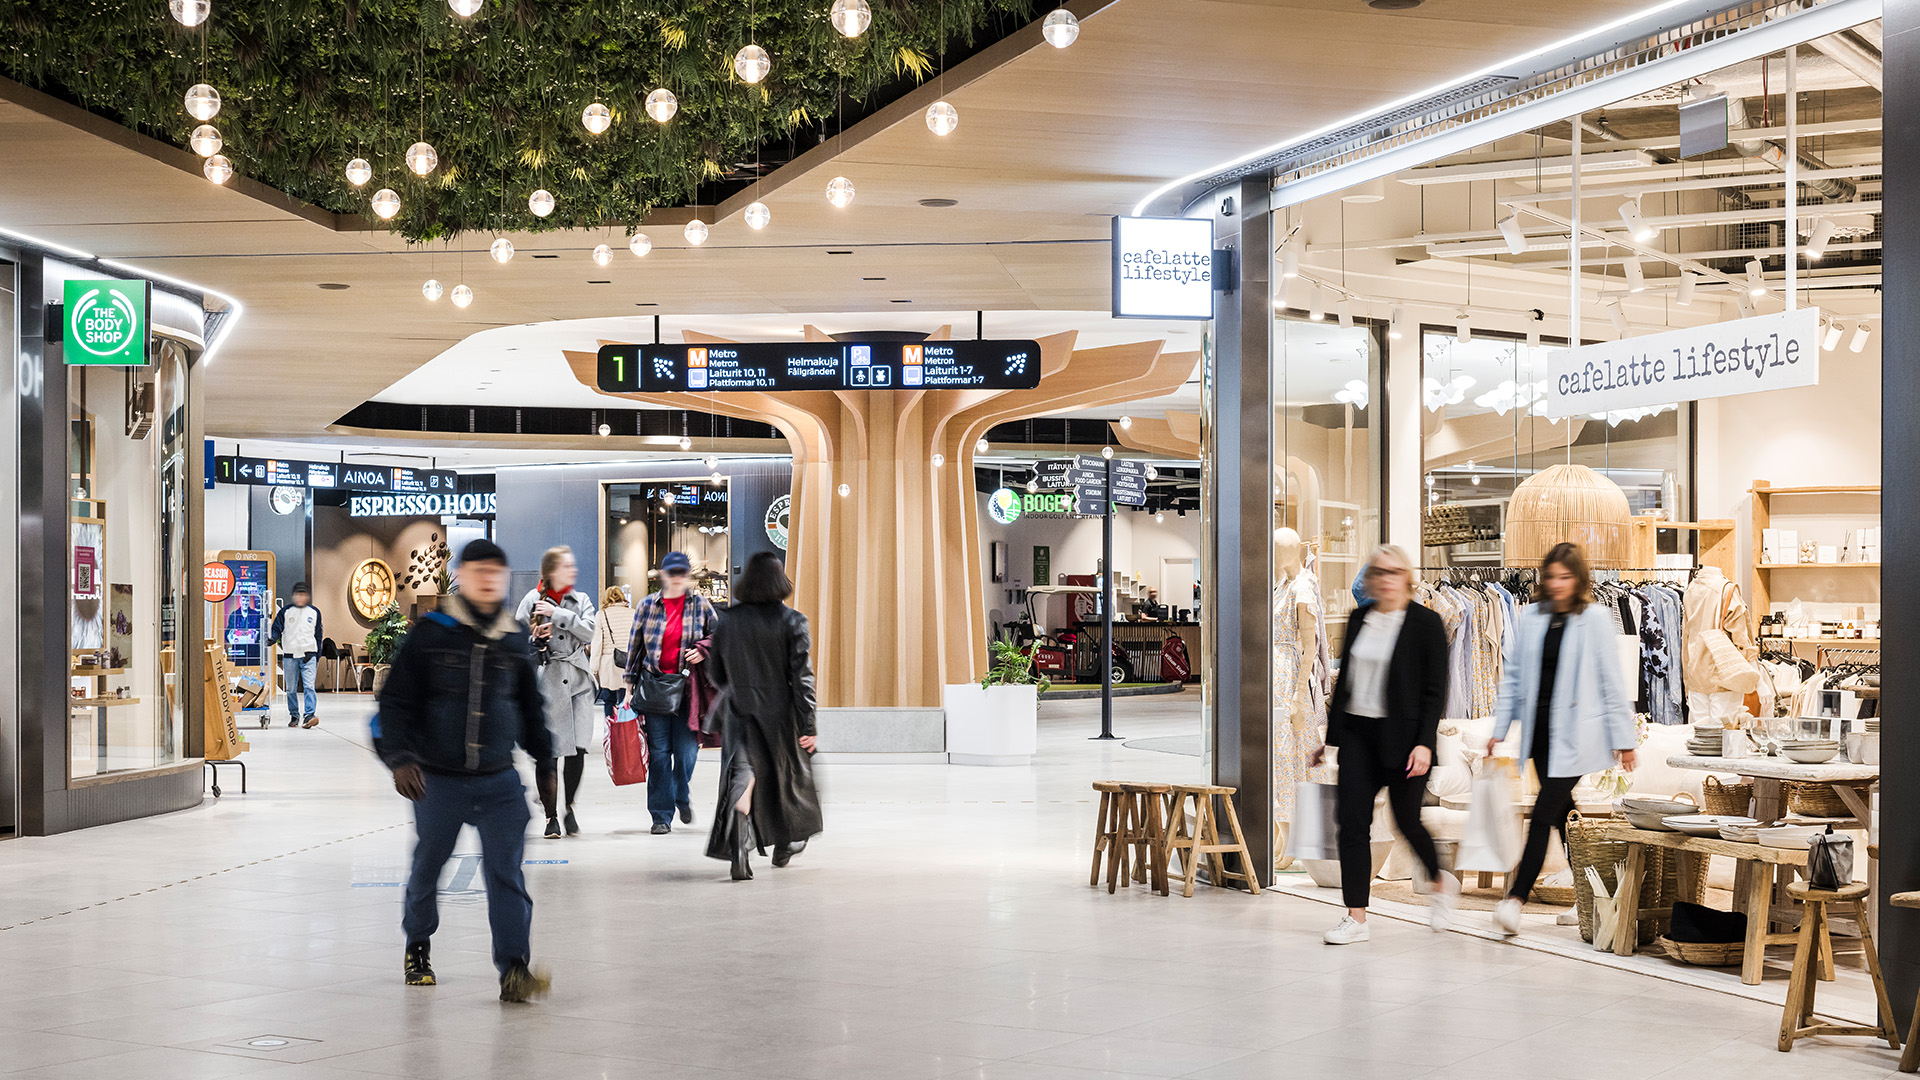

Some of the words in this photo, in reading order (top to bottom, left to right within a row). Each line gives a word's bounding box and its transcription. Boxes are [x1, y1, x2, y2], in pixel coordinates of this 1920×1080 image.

[1123, 249, 1210, 266] cafelatte
[1123, 265, 1211, 285] lifestyle
[93, 308, 116, 318] THE
[85, 318, 123, 330] BODY
[85, 331, 123, 343] SHOP
[690, 350, 706, 366] M
[709, 350, 737, 358] Metro
[905, 347, 921, 363] M
[925, 347, 954, 356] Metro
[709, 359, 738, 367] Metron
[787, 356, 839, 367] Helmakuja
[925, 357, 955, 365] Metron
[1558, 353, 1665, 396] cafelatte
[1673, 333, 1800, 379] lifestyle
[612, 356, 624, 382] 1
[709, 368, 743, 378] Laiturit
[744, 369, 757, 379] 10,
[758, 369, 766, 378] 11
[925, 366, 958, 375] Laiturit
[960, 366, 974, 375] 1-7
[709, 378, 755, 387] Plattformar
[756, 379, 767, 388] 10,
[768, 379, 776, 387] 11
[925, 376, 971, 385] Plattformar
[972, 376, 985, 385] 1-7
[222, 461, 229, 478] 1
[343, 470, 386, 486] AINOA
[350, 494, 442, 517] ESPRESSO
[443, 492, 496, 516] HOUS
[769, 498, 791, 519] ESPR
[1023, 494, 1075, 513] BOGEY
[243, 553, 258, 561] INFO
[204, 581, 227, 594] SALE
[216, 659, 225, 681] THE
[219, 684, 230, 713] BODY
[226, 716, 237, 746] SHOP
